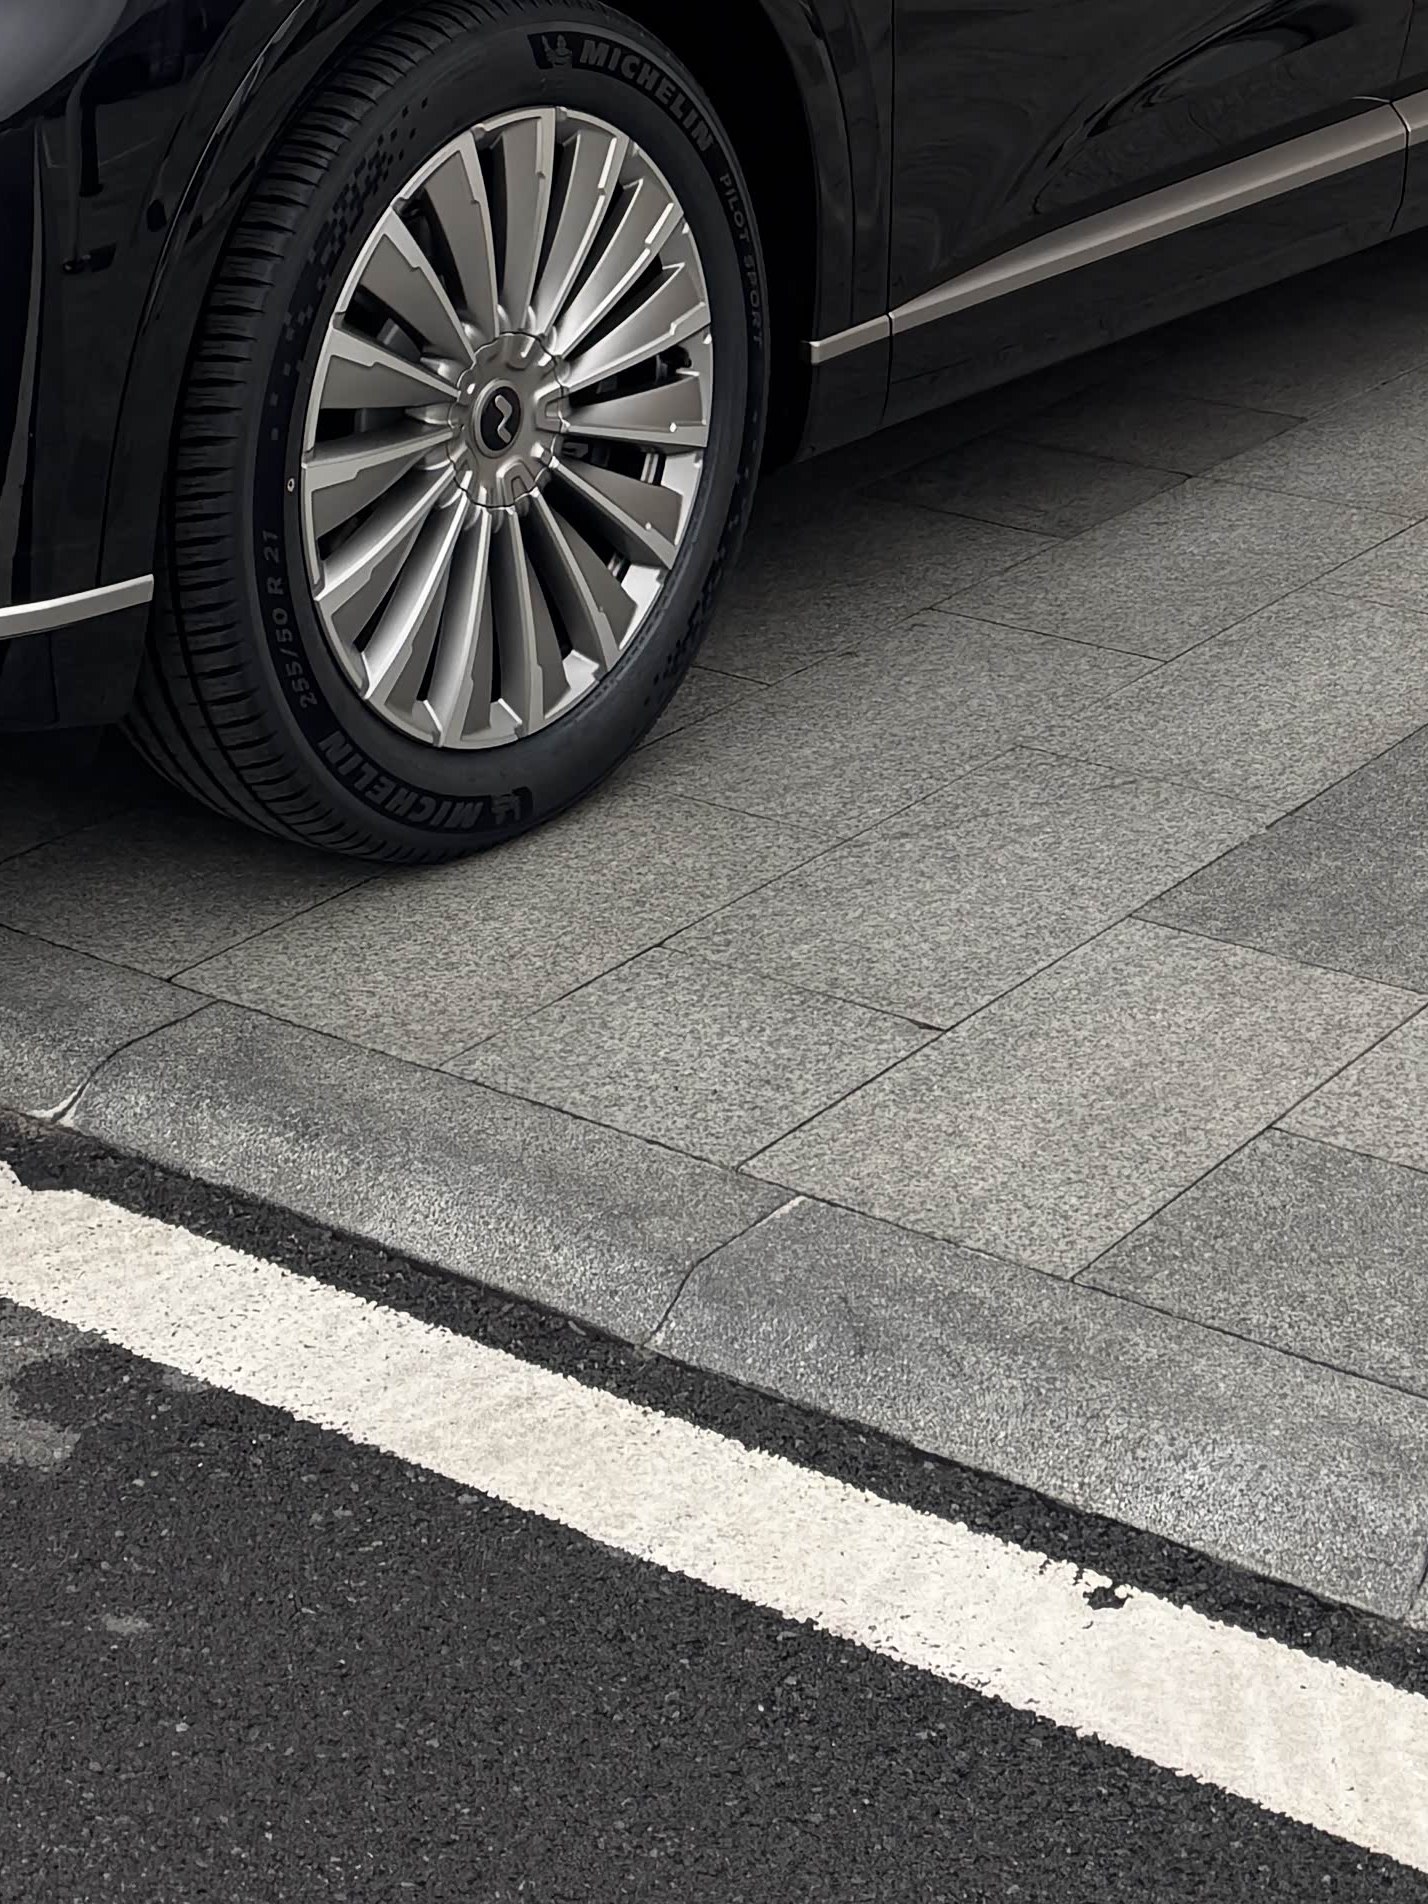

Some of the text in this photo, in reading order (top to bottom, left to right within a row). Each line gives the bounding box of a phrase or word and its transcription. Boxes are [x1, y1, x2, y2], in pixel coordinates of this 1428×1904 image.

[580, 39, 764, 348] MICHELIN PILOT SPORT
[273, 608, 318, 709] 255/50
[319, 731, 484, 829] MICHELIN
